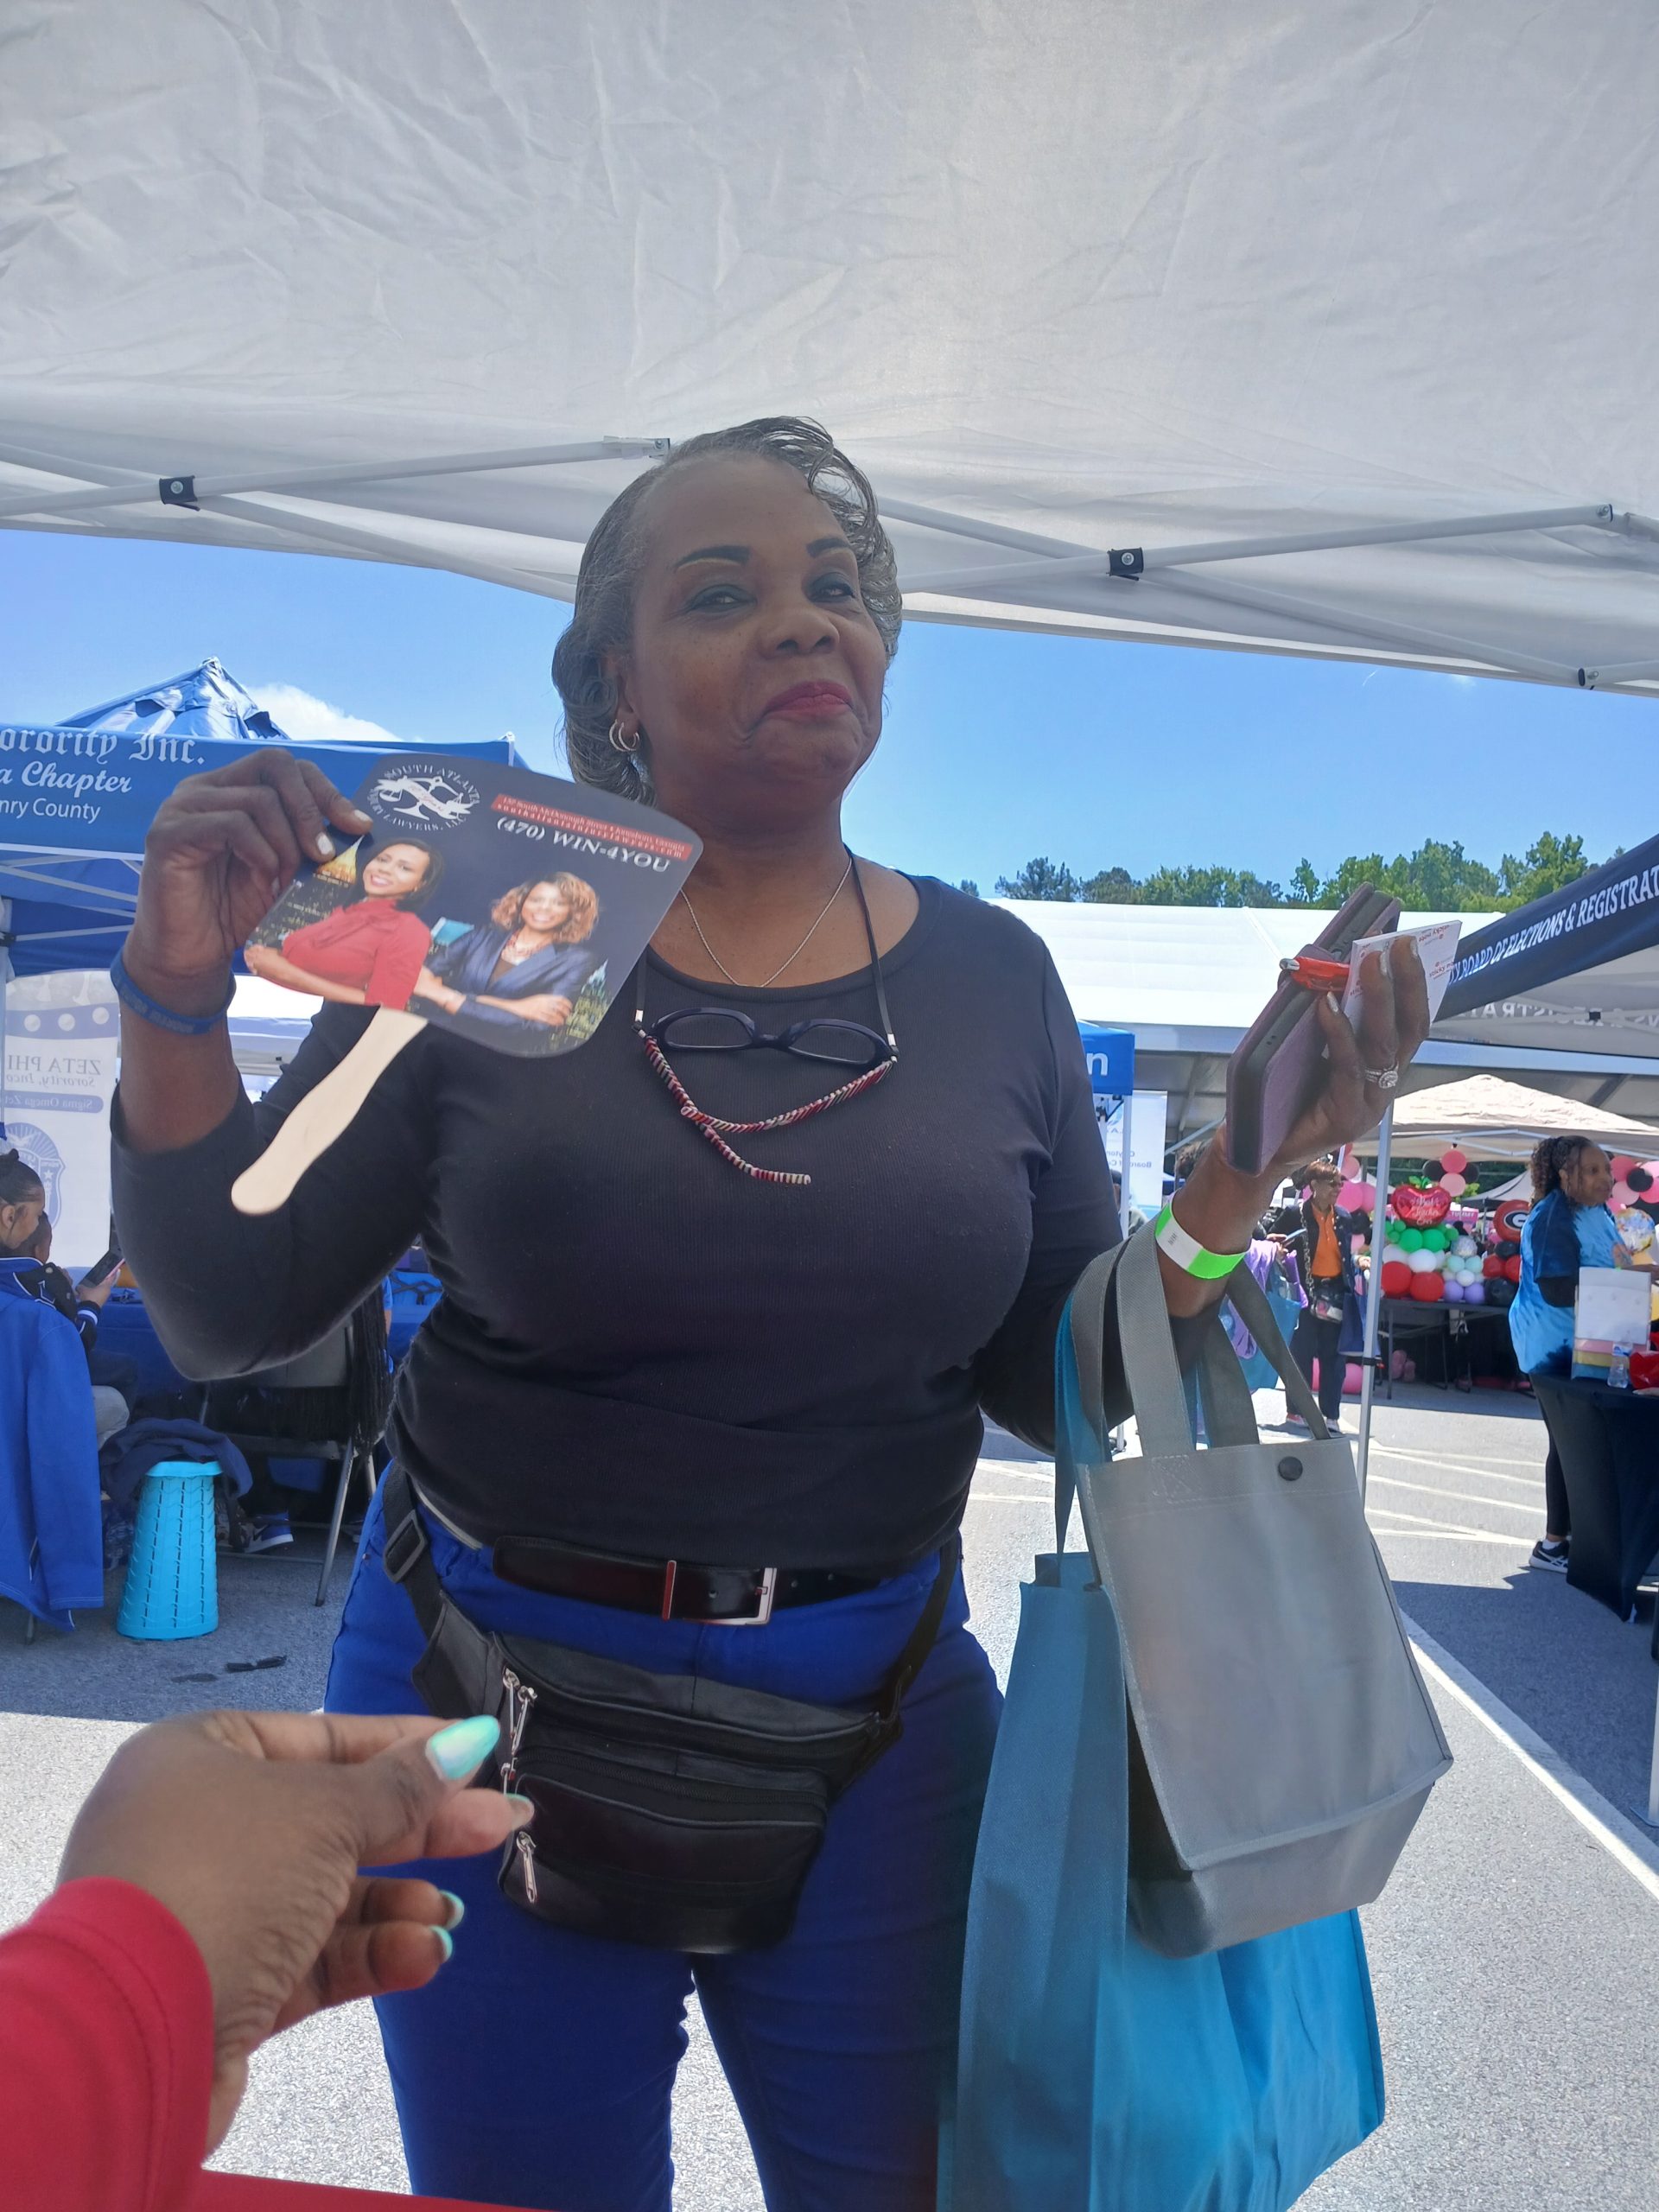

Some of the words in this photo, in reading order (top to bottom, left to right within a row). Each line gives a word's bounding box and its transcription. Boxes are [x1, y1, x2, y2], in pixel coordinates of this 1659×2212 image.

[129, 731, 206, 765] Inc.
[21, 760, 132, 798] Chapter
[32, 798, 101, 824] County
[497, 816, 545, 841] (470)
[553, 830, 671, 873] WIN-4YOU
[1458, 945, 1494, 981] BOARD
[1490, 938, 1509, 965] OF
[1502, 908, 1567, 960] ELECTIONS
[1565, 901, 1577, 932] &
